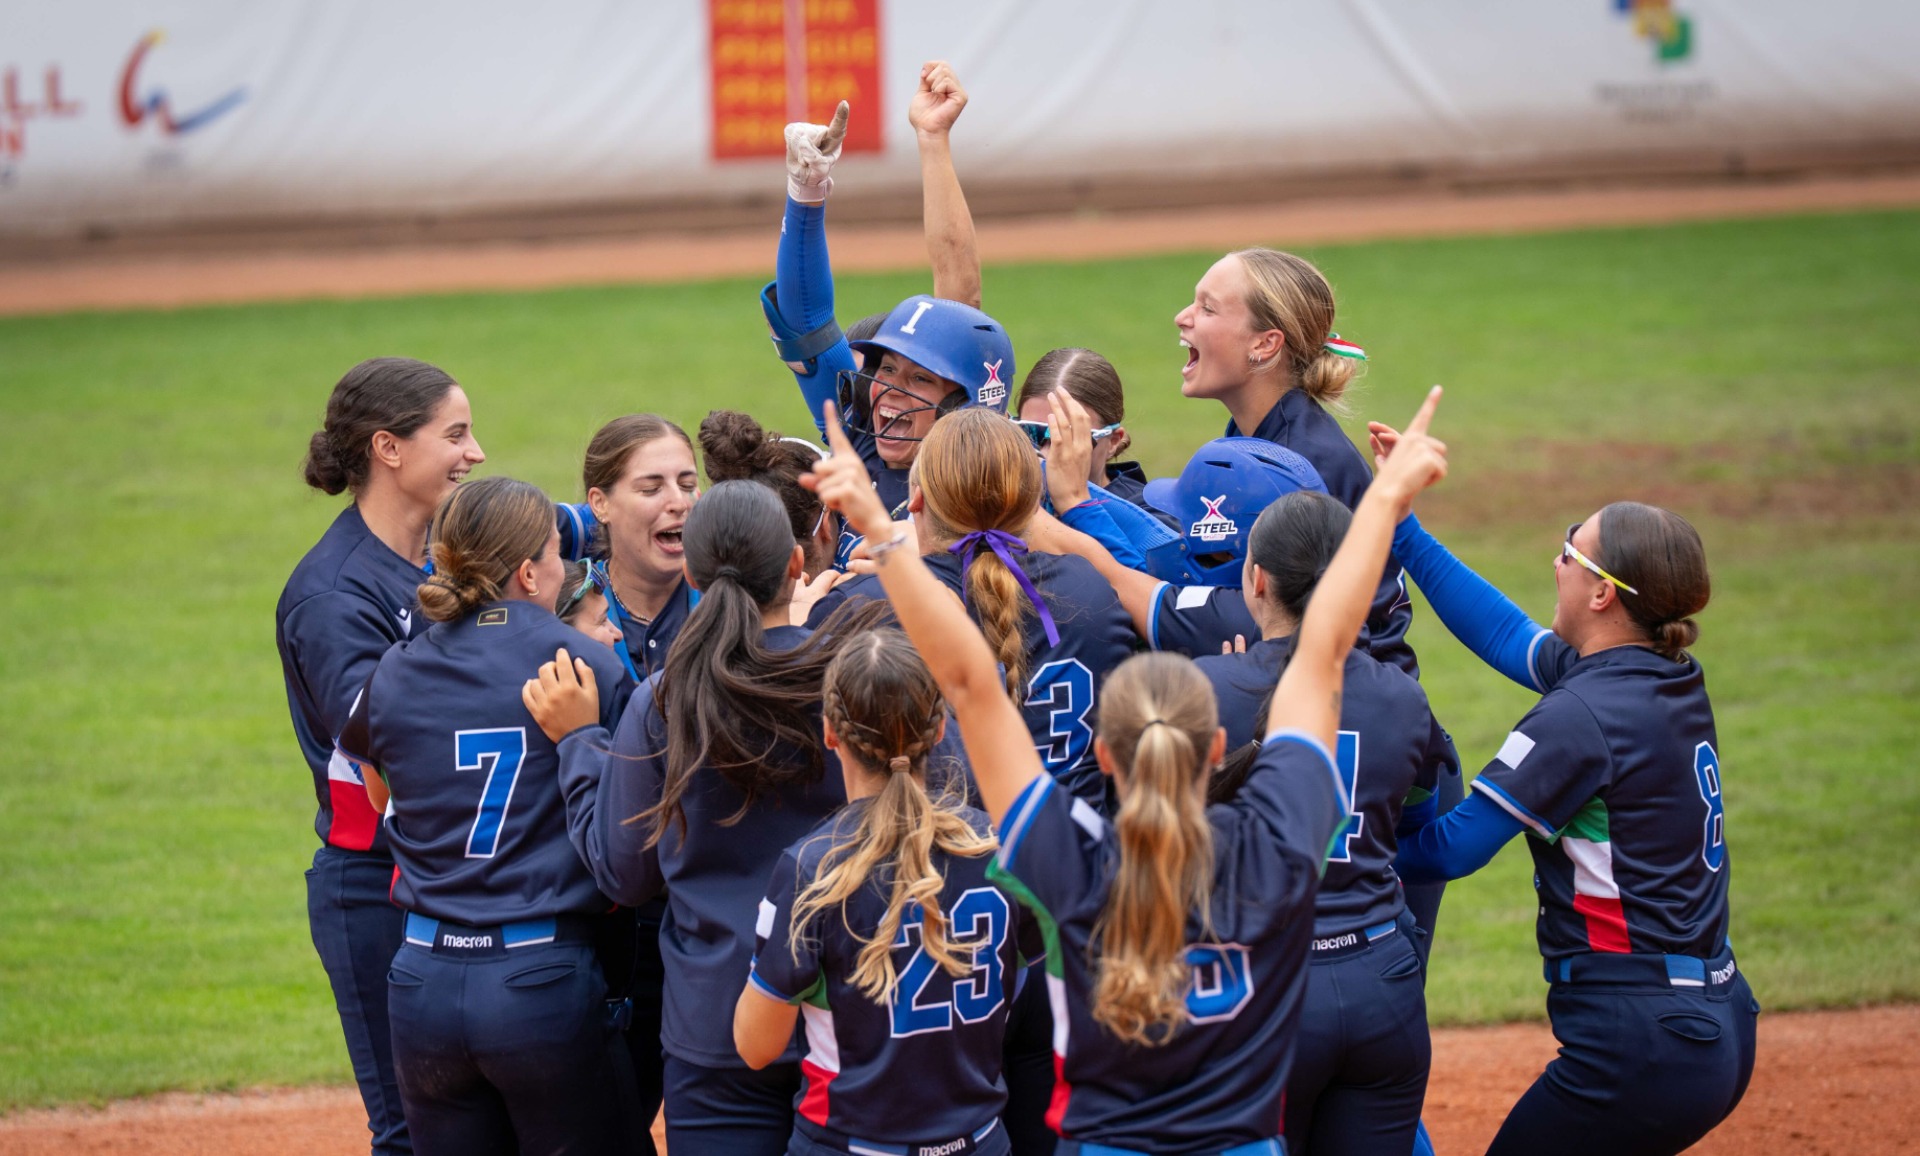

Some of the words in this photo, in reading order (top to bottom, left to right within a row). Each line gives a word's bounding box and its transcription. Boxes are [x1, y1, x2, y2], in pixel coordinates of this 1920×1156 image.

[900, 301, 933, 335] I
[979, 385, 1005, 401] STEEL
[1191, 521, 1236, 535] STEEL
[455, 727, 526, 859] 7
[1694, 740, 1723, 873] 8
[443, 934, 492, 949] macron
[879, 886, 1009, 1038] 23
[919, 1137, 966, 1156] macron
